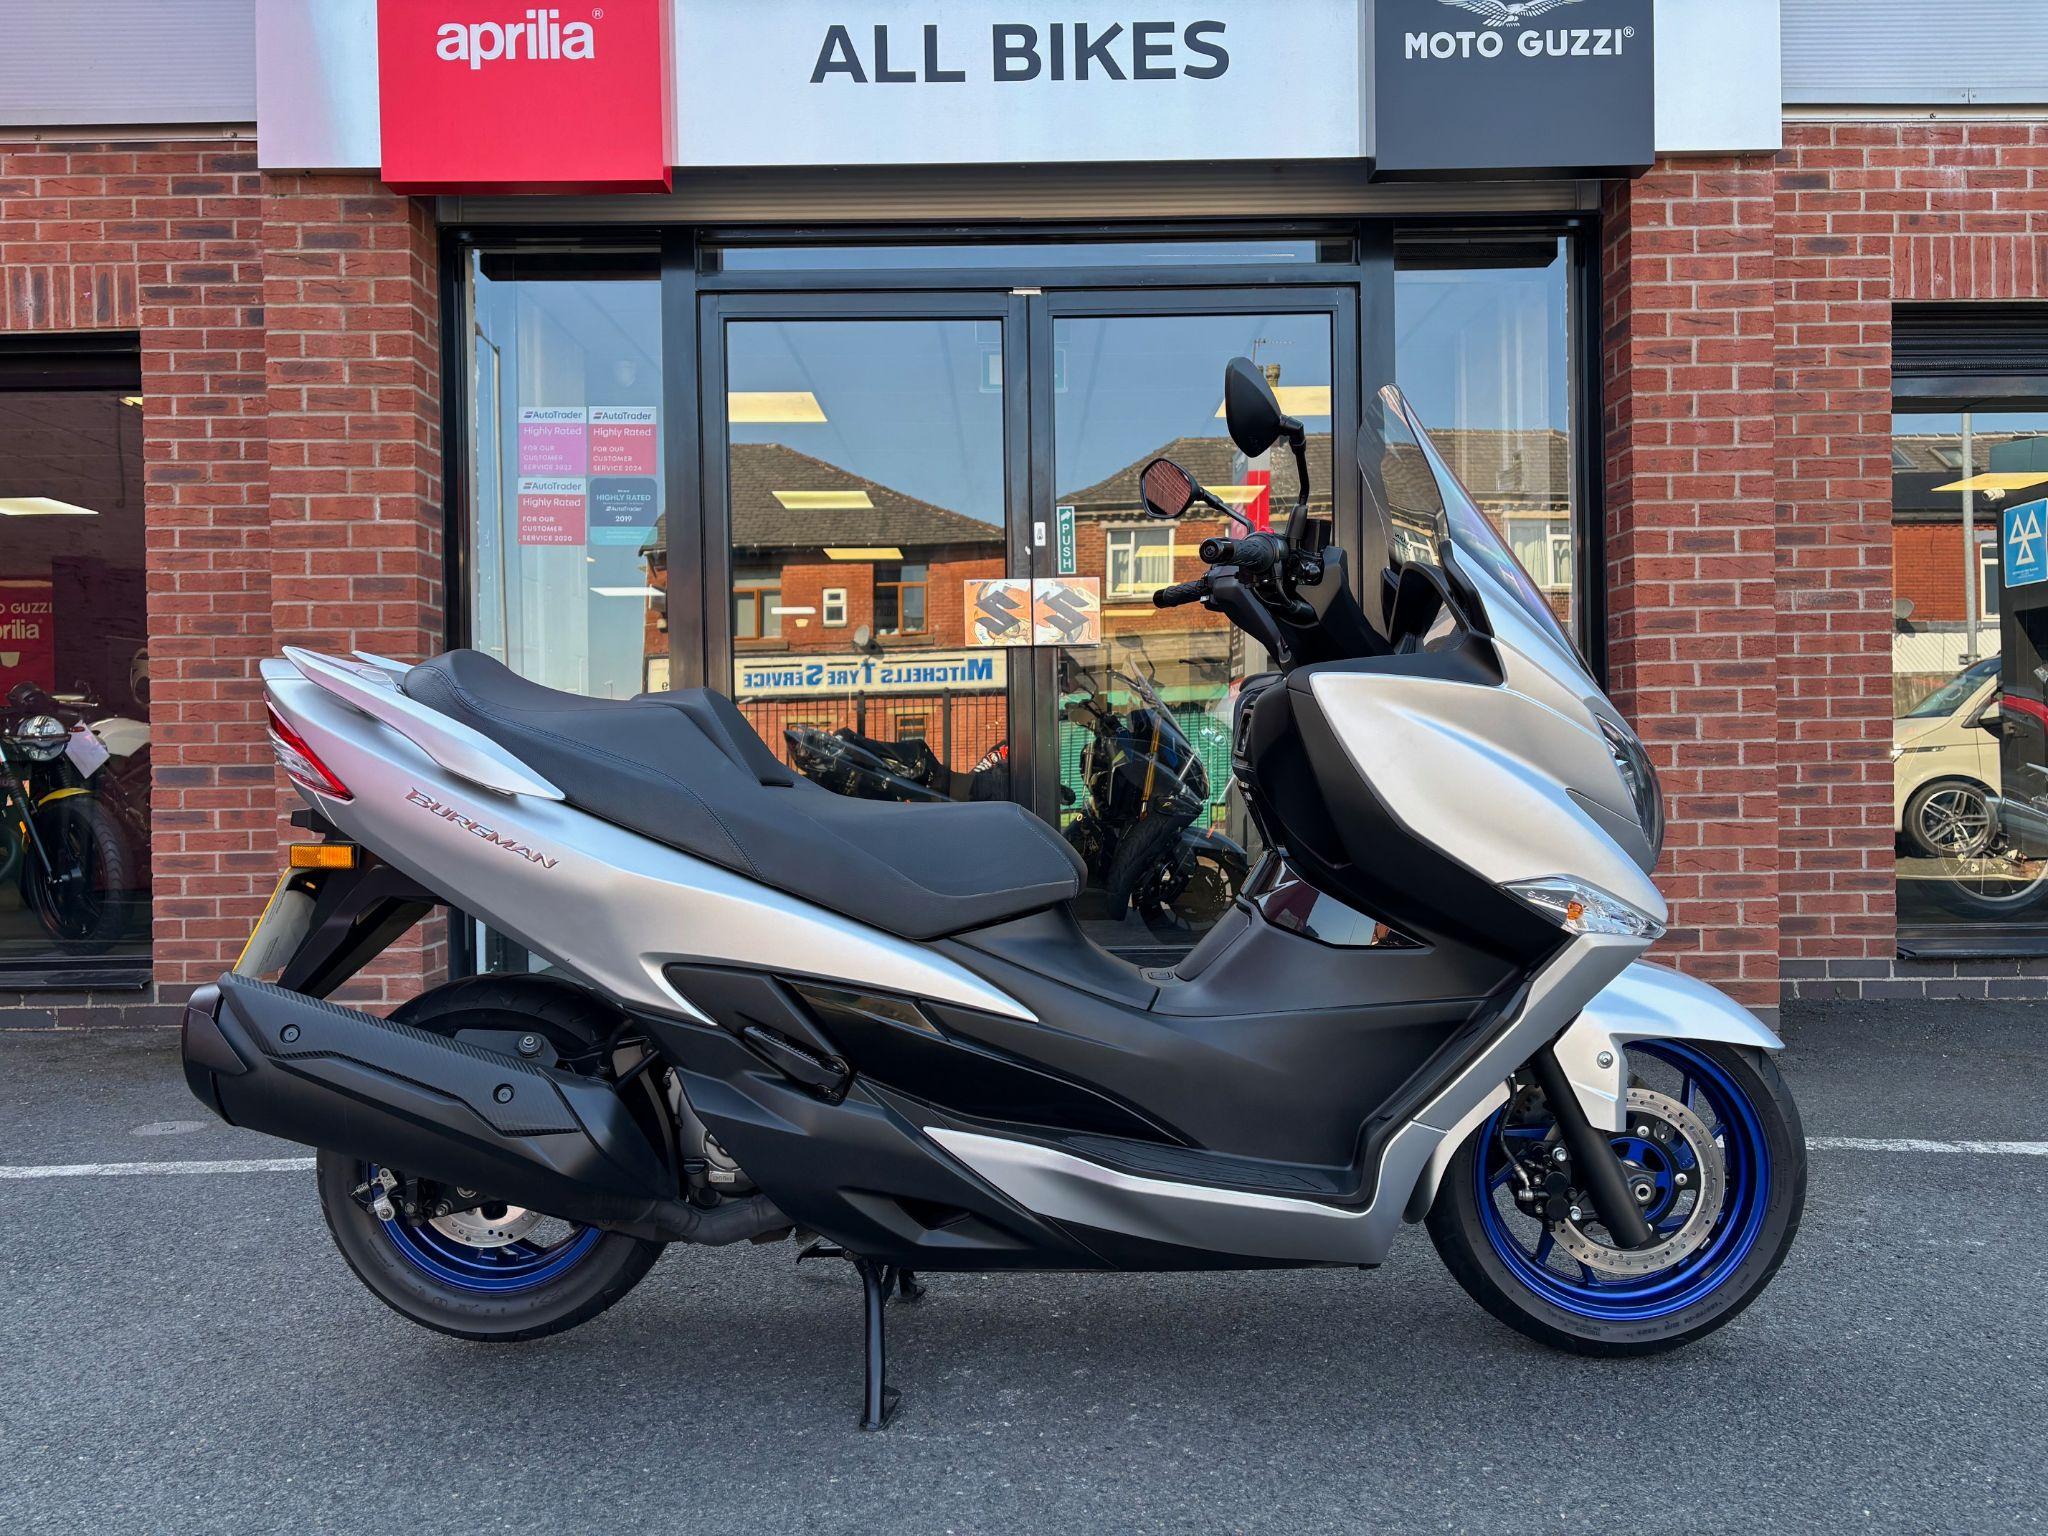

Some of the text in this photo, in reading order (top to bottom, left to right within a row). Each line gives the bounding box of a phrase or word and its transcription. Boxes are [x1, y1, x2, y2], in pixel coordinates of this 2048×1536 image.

[1405, 31, 1504, 59] MOTO
[809, 20, 1230, 83] ALL BIKES
[533, 411, 582, 419] AutoTrader
[602, 411, 652, 420] AutoTrader
[524, 427, 582, 437] Highly Rated
[593, 428, 651, 438] Highly Rated
[532, 482, 582, 490] AutoTrader
[522, 498, 581, 508] Highly Rated
[1062, 524, 1071, 568] PUSH
[11, 602, 53, 614] GUZZI
[0, 619, 39, 640] rilia
[405, 787, 559, 869] BURGMAN
